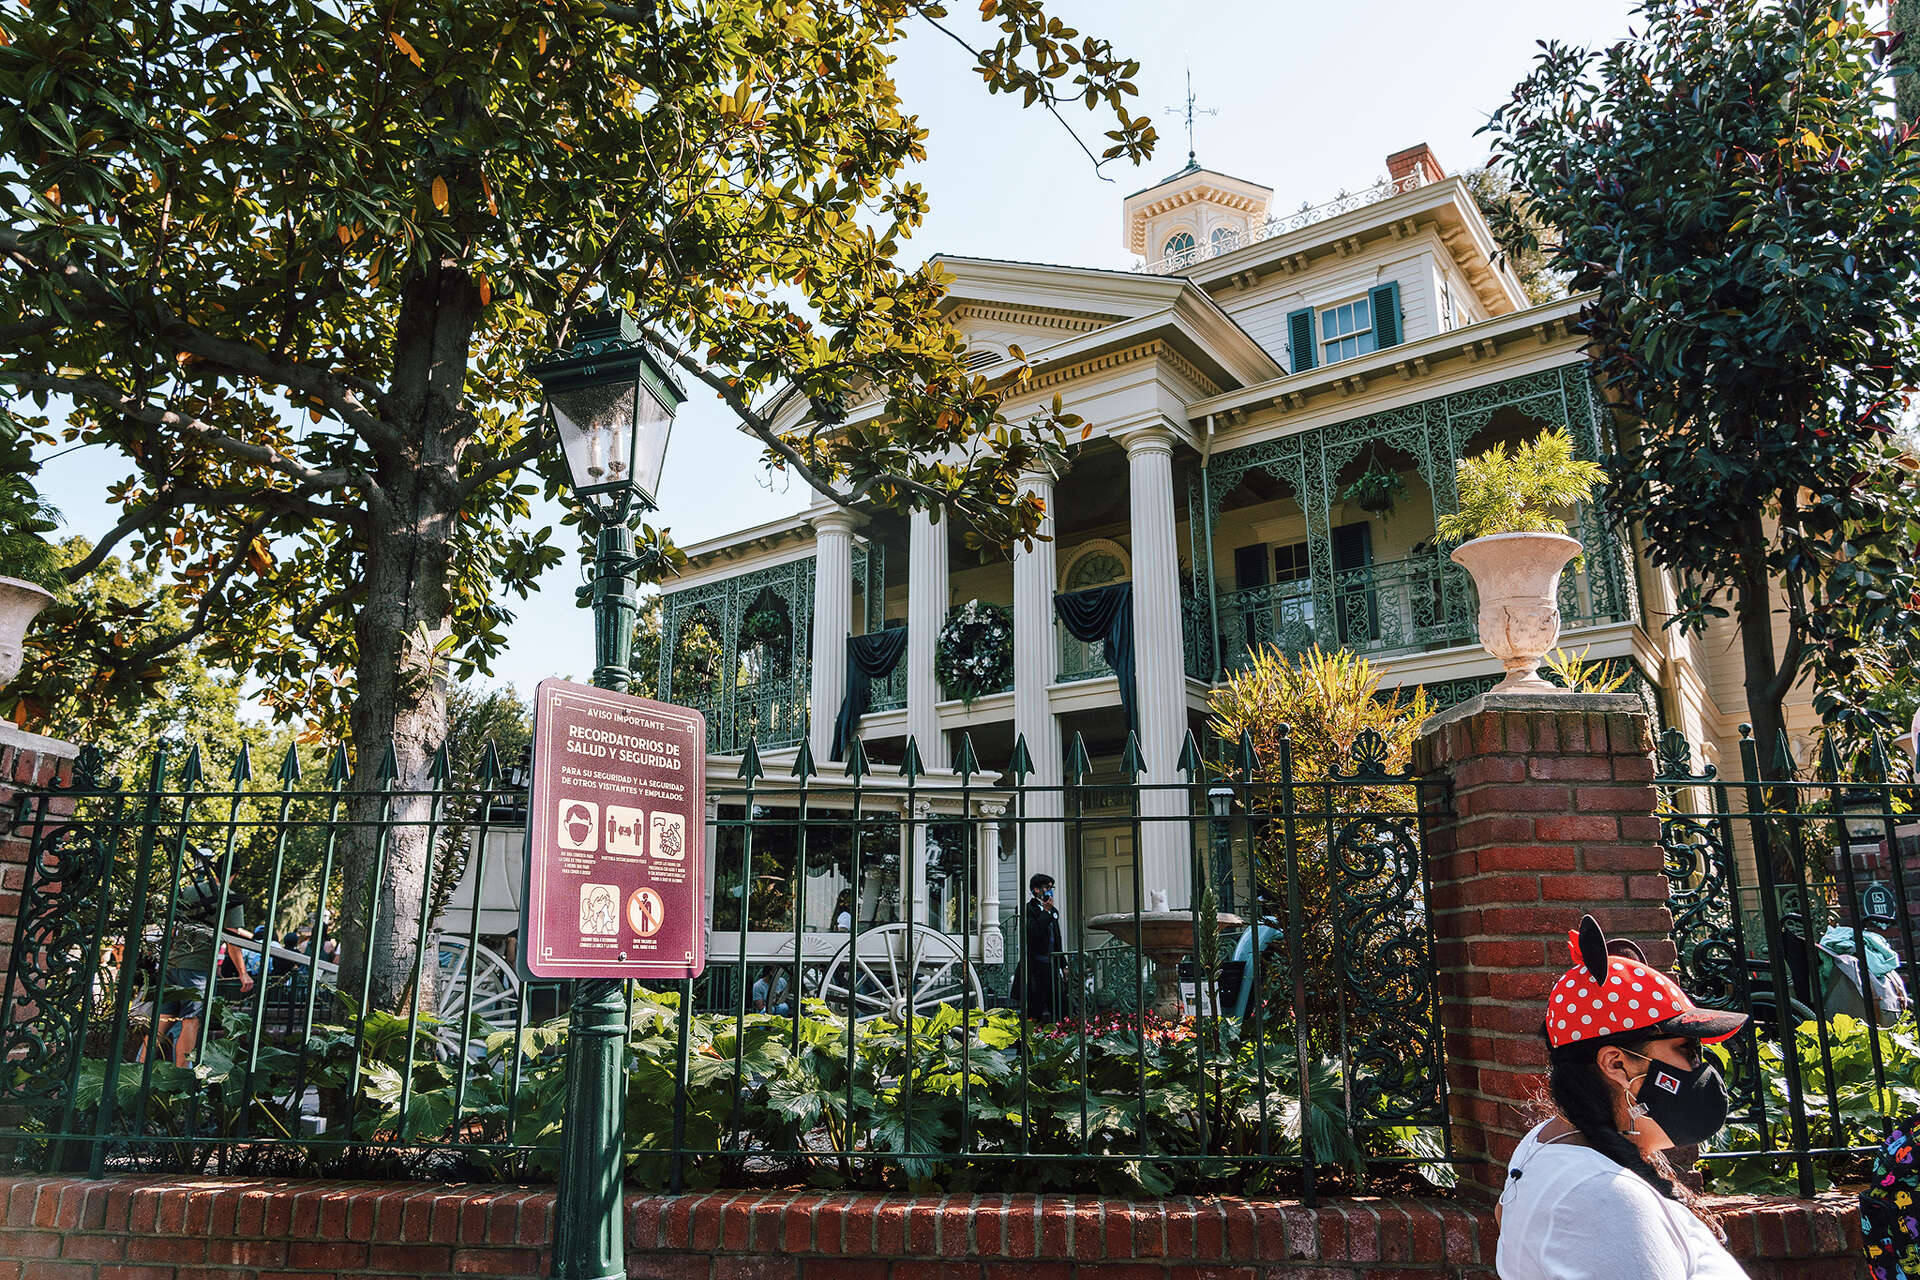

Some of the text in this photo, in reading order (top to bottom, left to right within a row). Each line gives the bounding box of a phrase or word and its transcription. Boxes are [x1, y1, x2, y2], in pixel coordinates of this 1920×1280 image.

[587, 708, 665, 731] AVISO IMPORTANTE
[569, 724, 680, 757] RECORDATORIOS DE
[566, 740, 682, 771] SALUD Y SEGURIDAD
[561, 765, 685, 792] PARA SU SEGURIDAD Y LA SEGURIDAD
[561, 776, 572, 785] DE
[572, 778, 597, 789] OTROS
[598, 782, 638, 795] VISITANTES
[639, 788, 644, 796] Y
[1873, 904, 1888, 914] EXIT
